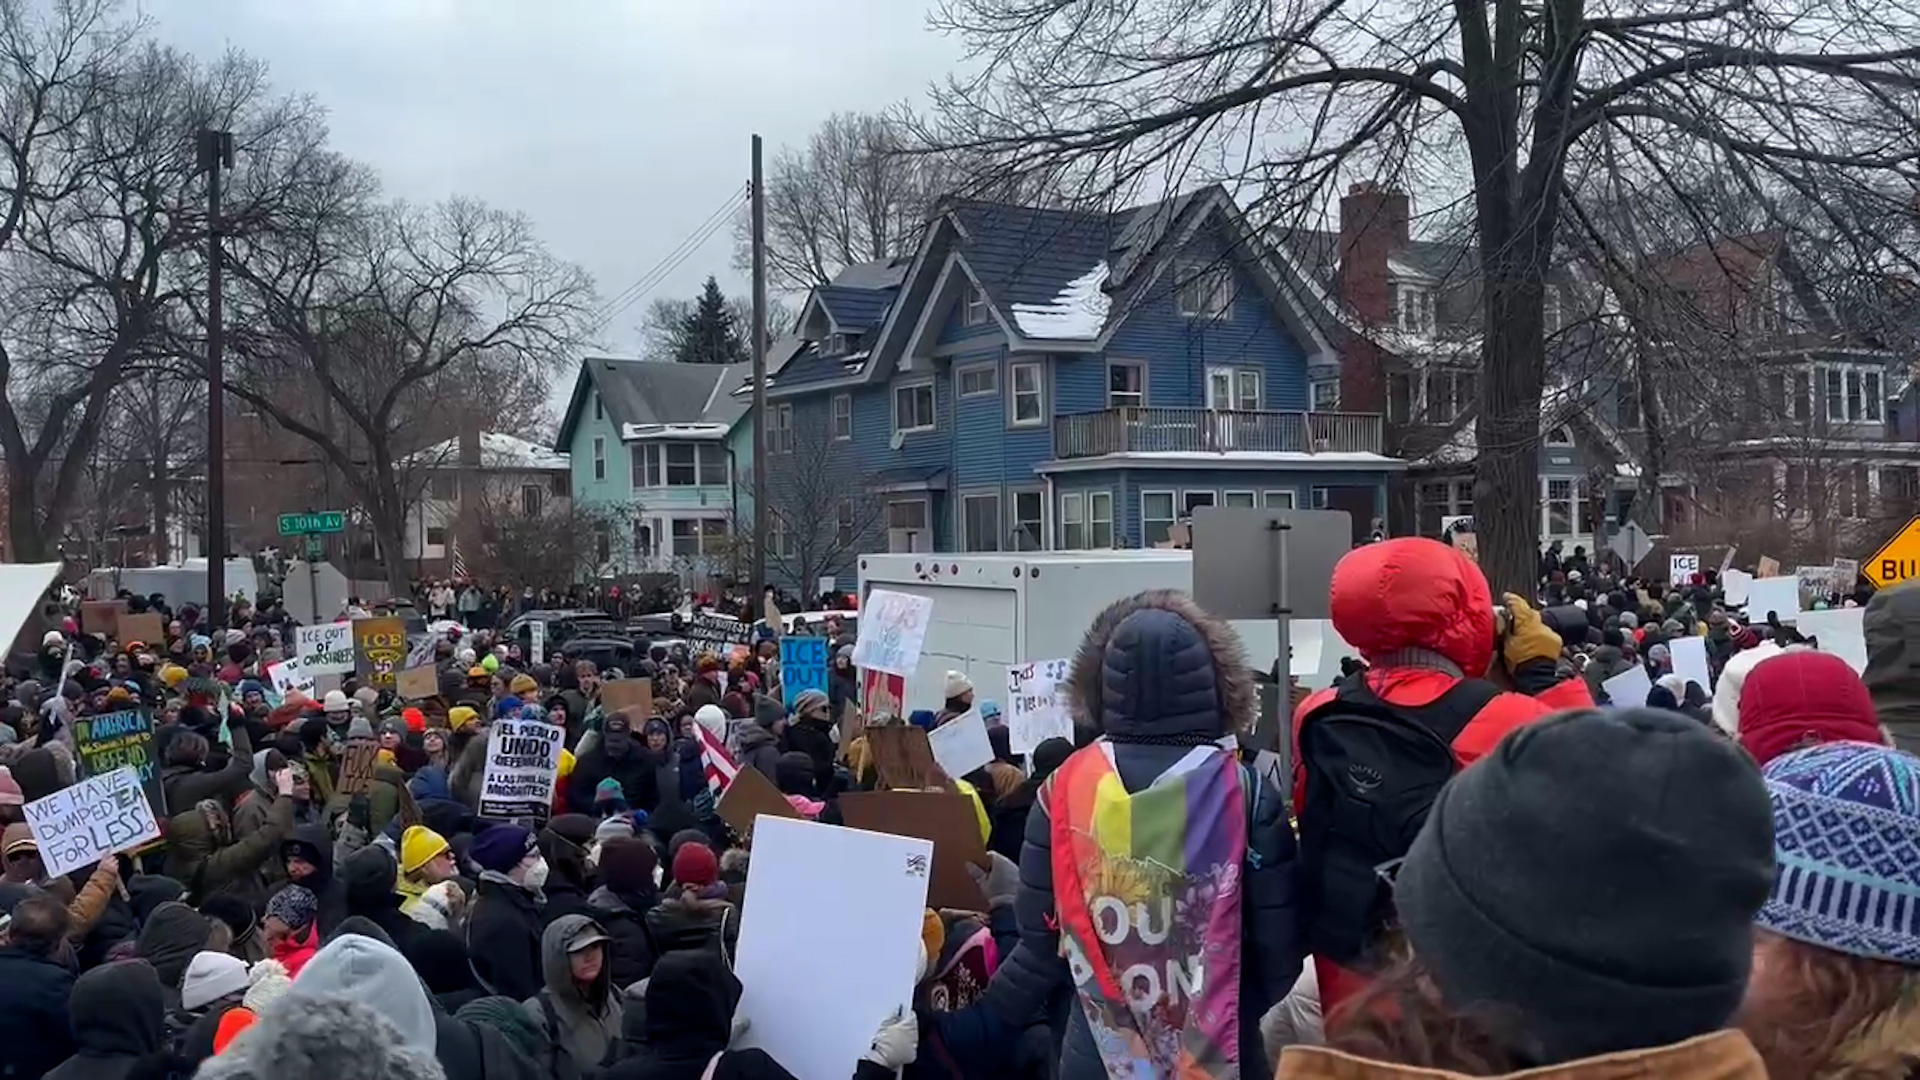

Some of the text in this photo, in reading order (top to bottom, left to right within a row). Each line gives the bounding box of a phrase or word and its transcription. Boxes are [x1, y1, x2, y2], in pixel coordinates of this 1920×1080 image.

[282, 518, 290, 531] S
[1673, 557, 1697, 571] ICE
[1882, 560, 1915, 579] BU
[302, 627, 347, 644] ICE OUT
[363, 633, 402, 648] ICE
[316, 641, 332, 653] OF
[781, 639, 824, 664] ICE
[783, 667, 825, 686] OUT
[92, 710, 147, 739] AMERICA
[25, 796, 61, 821] WE
[69, 770, 130, 806] HAVE
[39, 786, 144, 841] DUMPED TEA
[48, 835, 90, 871] FOR
[1093, 895, 1171, 946] OU
[1120, 954, 1204, 1011] ON
